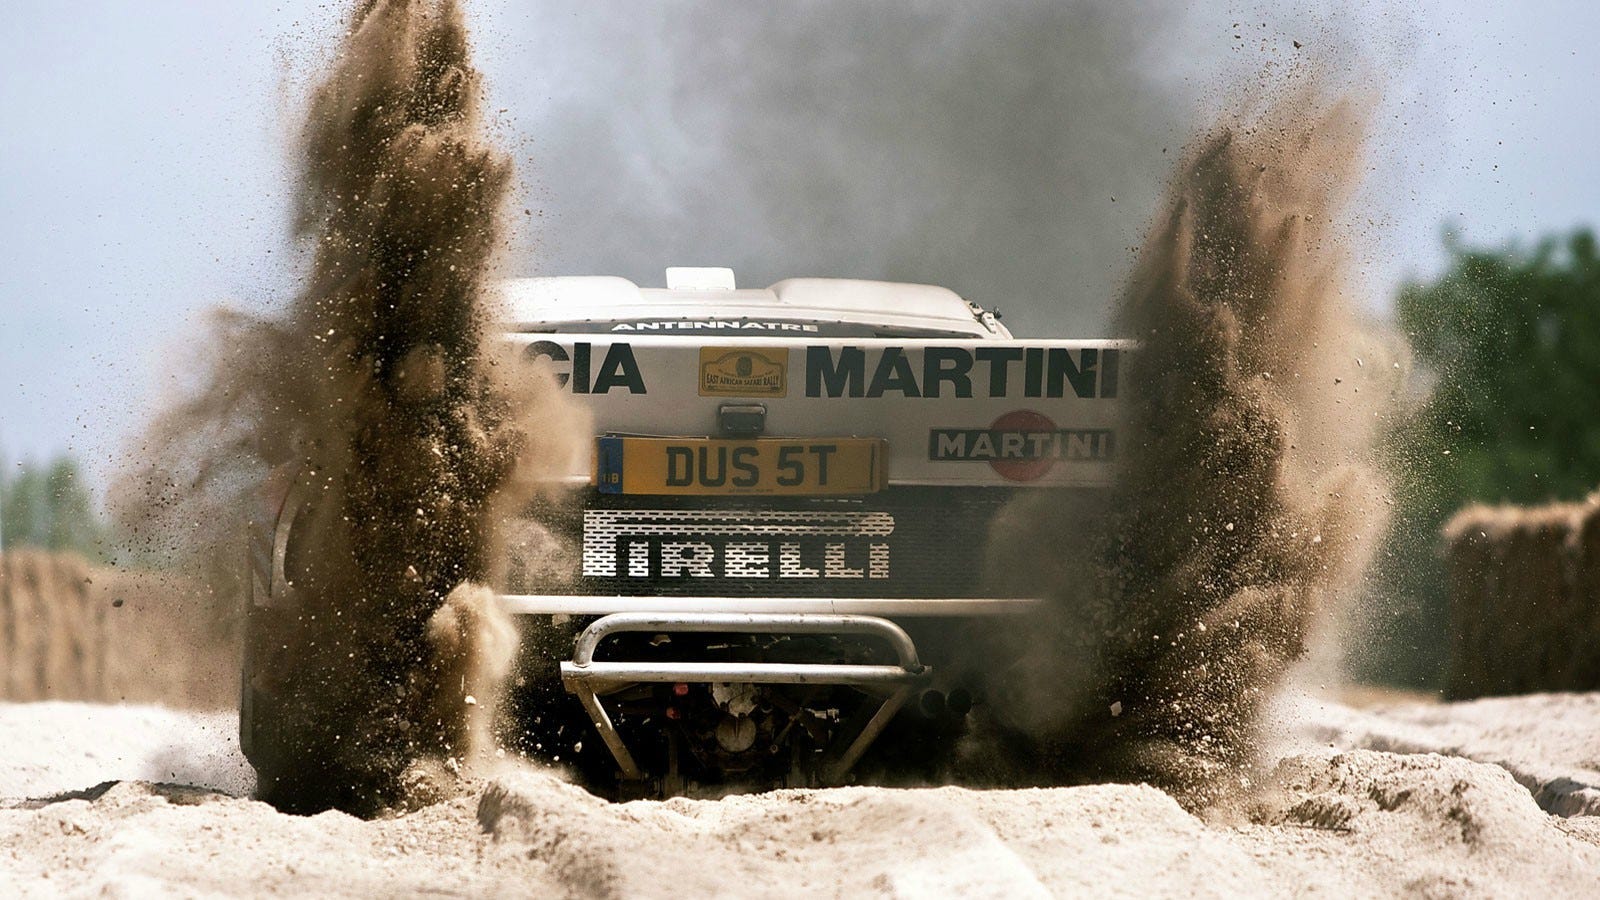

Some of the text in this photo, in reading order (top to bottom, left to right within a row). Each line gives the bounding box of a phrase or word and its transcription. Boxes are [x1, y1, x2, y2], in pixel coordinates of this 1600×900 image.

[706, 373, 719, 385] EAST
[720, 376, 742, 386] AFRICAN
[744, 378, 762, 386] SAFARI
[763, 375, 779, 386] RALLY
[805, 345, 1119, 398] MARTINI
[666, 445, 837, 487] DUS 5T
[937, 432, 1106, 458] MARTINI
[582, 509, 895, 579] PIRELLI
